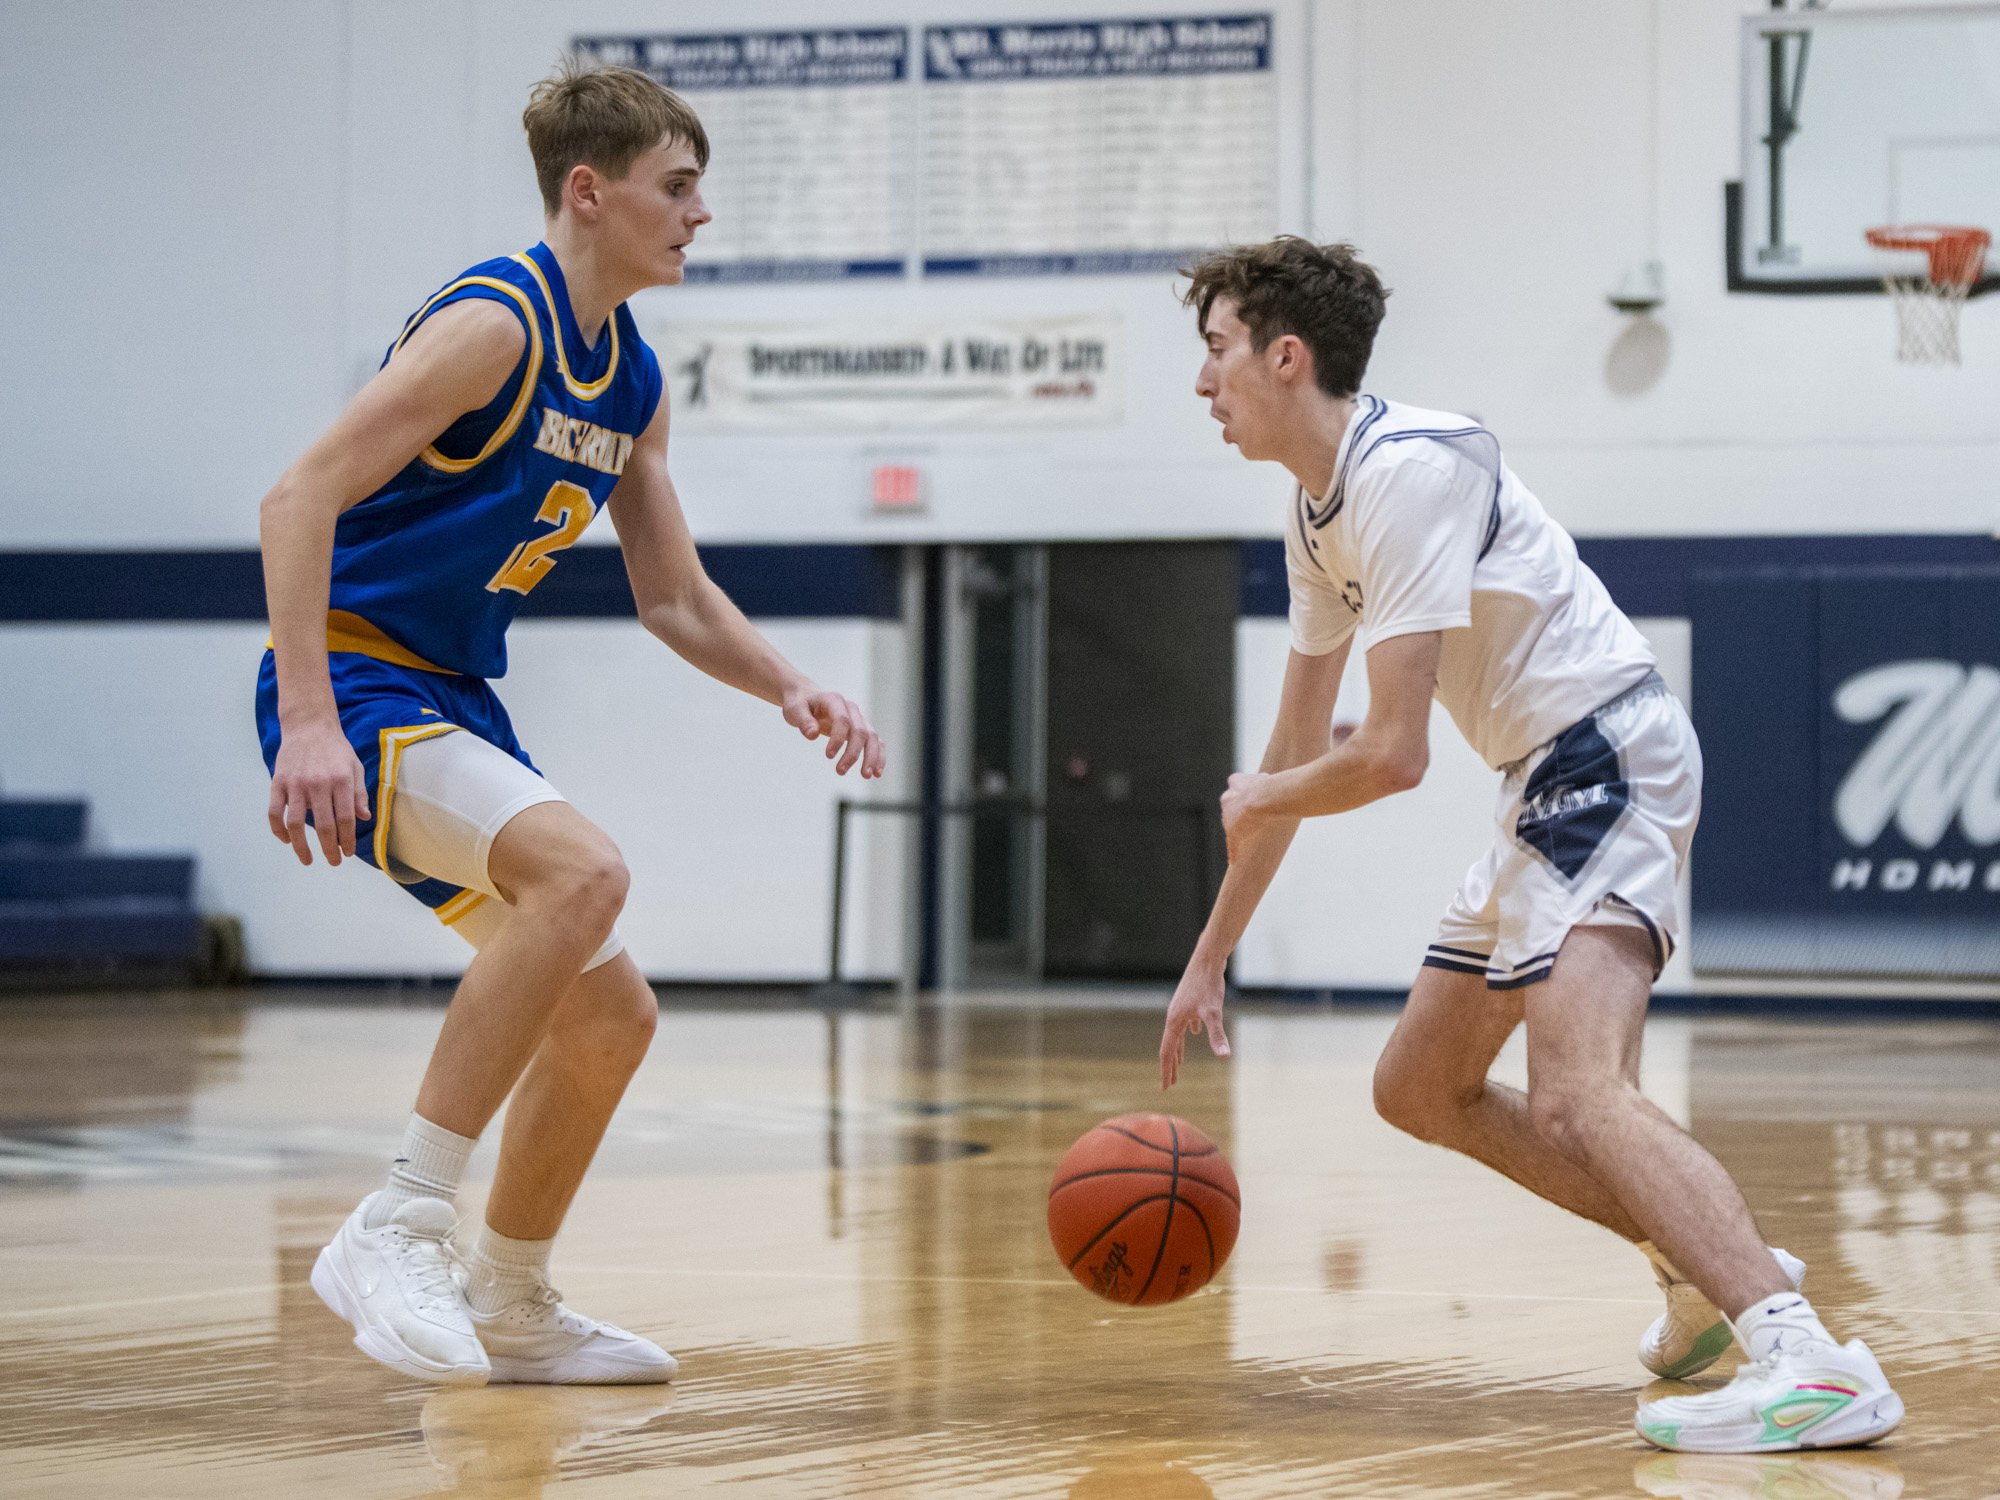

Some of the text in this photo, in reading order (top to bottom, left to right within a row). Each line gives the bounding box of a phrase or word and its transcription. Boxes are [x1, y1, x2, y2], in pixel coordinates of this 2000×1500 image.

[742, 36, 810, 66] High
[813, 34, 905, 59] School
[1100, 24, 1170, 55] High
[1173, 21, 1266, 48] School
[484, 479, 597, 596] 2
